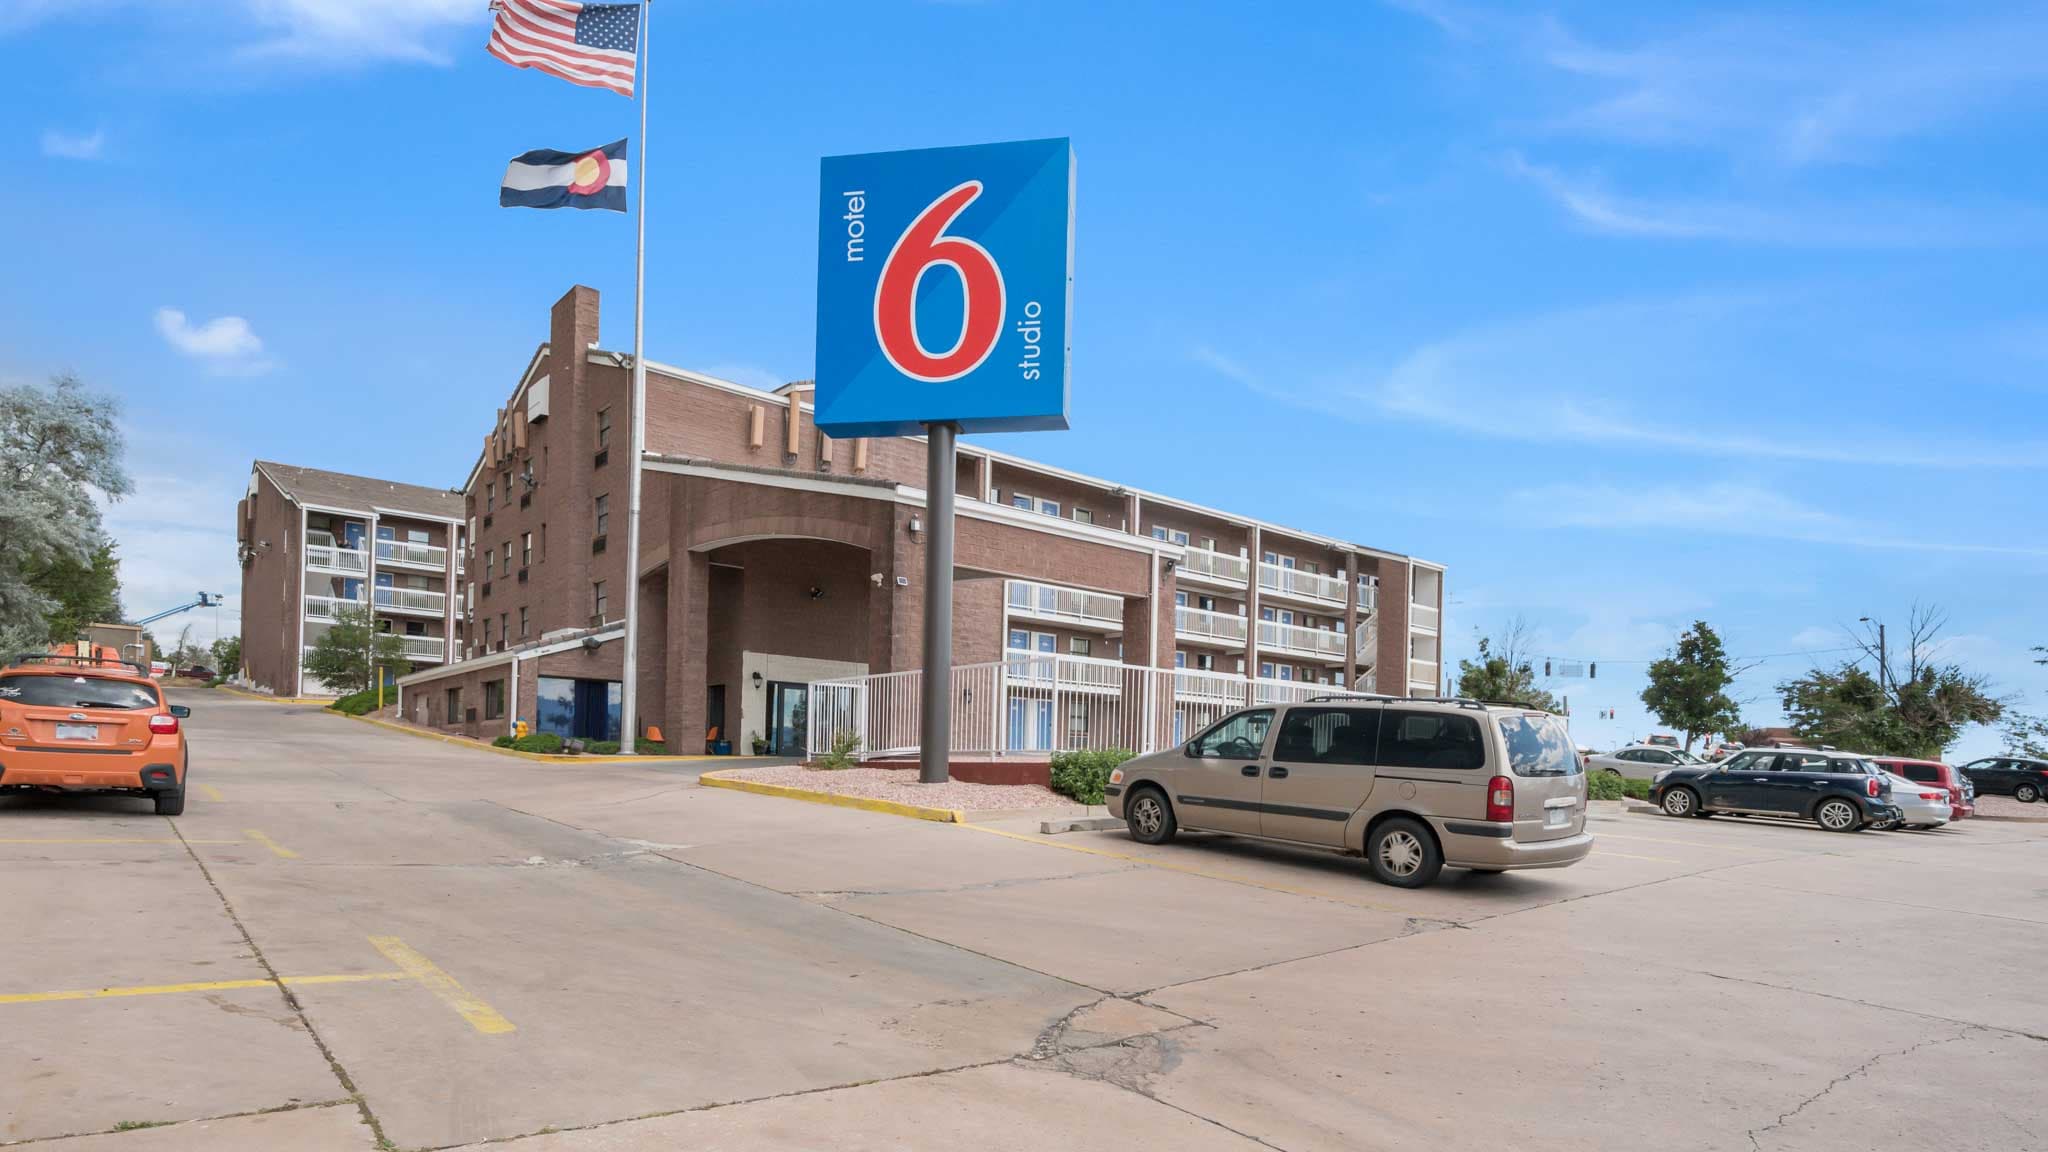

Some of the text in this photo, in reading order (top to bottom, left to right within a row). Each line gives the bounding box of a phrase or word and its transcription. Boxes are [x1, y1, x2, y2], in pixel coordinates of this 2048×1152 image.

[843, 190, 865, 262] motel
[873, 180, 1007, 383] 6
[1017, 300, 1042, 380] studio
